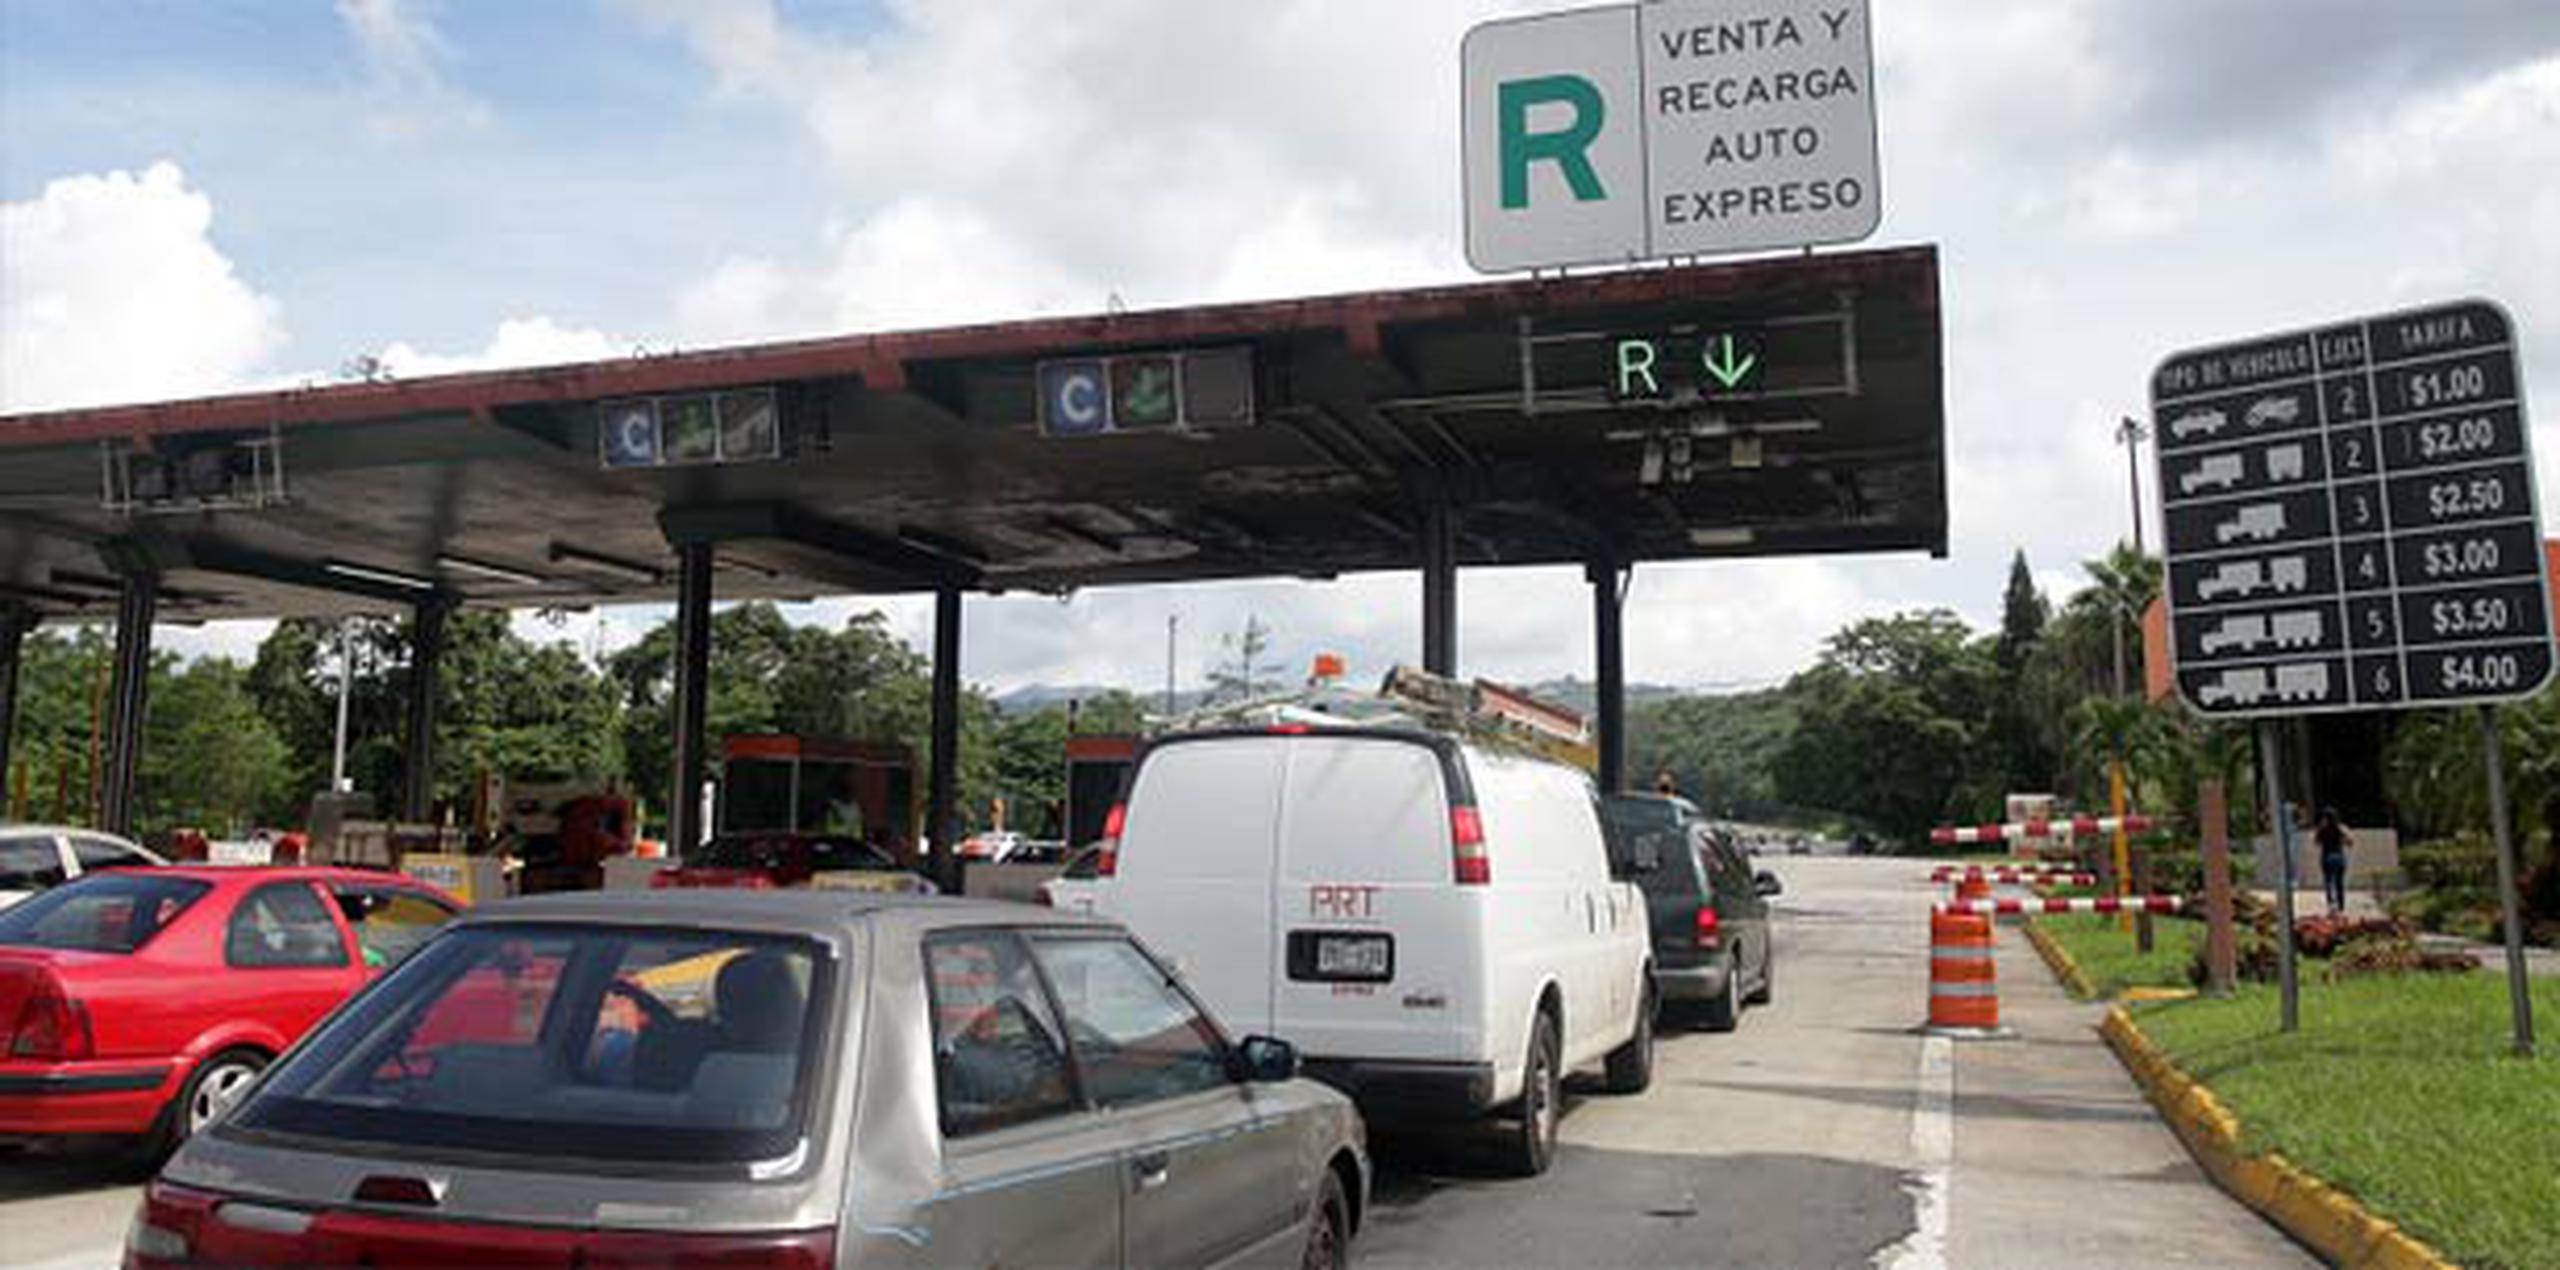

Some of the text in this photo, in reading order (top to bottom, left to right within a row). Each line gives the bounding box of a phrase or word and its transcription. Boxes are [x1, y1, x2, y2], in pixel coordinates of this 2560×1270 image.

[1660, 9, 1850, 59] VENTA Y
[1658, 66, 1858, 115] RECARGA
[1497, 74, 1609, 210] R
[1704, 126, 1820, 165] AUTO
[1663, 177, 1862, 224] EXPRESO
[2400, 315, 2474, 349] TARIFA
[1617, 339, 1659, 395] R
[2410, 364, 2484, 407] $1.00
[1062, 374, 1096, 424] C
[2342, 386, 2357, 415] 2
[622, 413, 651, 458] C
[2420, 416, 2495, 457] $2.00
[2346, 441, 2362, 469] 2
[2356, 496, 2370, 524] 3
[2429, 477, 2504, 517] $2.50
[2359, 552, 2375, 579] 4
[2424, 539, 2499, 576] $3.00
[2367, 610, 2383, 638] 5
[2432, 598, 2507, 634] $3.50
[2375, 665, 2391, 693] 6
[2441, 654, 2518, 689] $4.00
[1310, 885, 1382, 917] PRT
